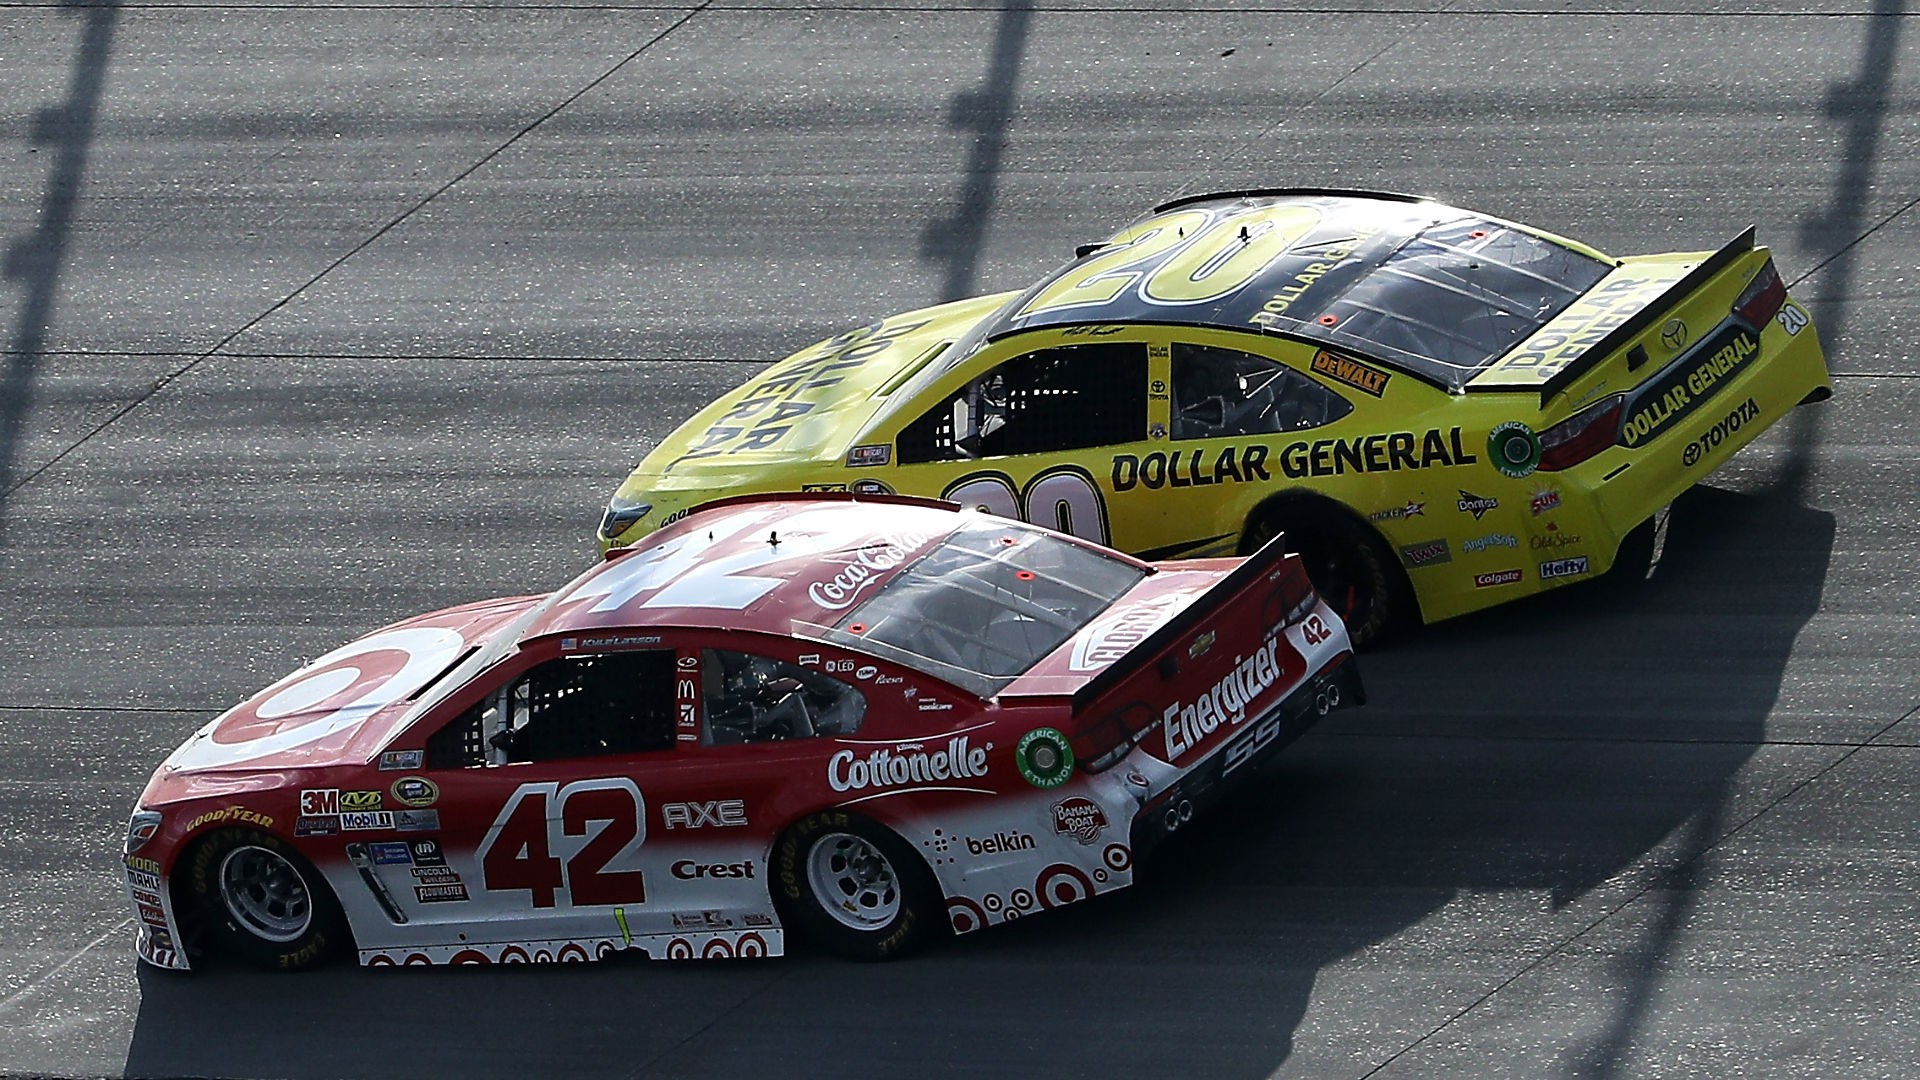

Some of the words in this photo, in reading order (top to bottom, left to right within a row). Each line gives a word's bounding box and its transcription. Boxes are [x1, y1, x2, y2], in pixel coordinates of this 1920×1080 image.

[1011, 203, 1325, 323] 20
[1248, 260, 1336, 327] DOLLAR
[1500, 279, 1650, 372] DOLLAR
[1775, 304, 1808, 336] 20
[1622, 386, 1690, 447] DOLLAR
[1687, 331, 1758, 396] GENERAL
[1490, 422, 1530, 442] AMERICAN
[1701, 398, 1760, 455] TOYOTA
[1111, 445, 1270, 492] DOLLAR
[1280, 427, 1478, 478] GENERAL
[1501, 462, 1538, 478] ETHANOL
[557, 502, 920, 614] 42
[1541, 558, 1586, 577] Hefty
[1478, 571, 1520, 584] Colgate
[1301, 614, 1333, 647] 42
[838, 662, 854, 672] LED
[1163, 636, 1281, 763] Energizer
[1018, 728, 1068, 757] AMERICAN
[828, 736, 988, 792] Cottonelle
[1024, 761, 1072, 787] ETHANOL
[302, 790, 338, 815] 3M
[662, 799, 748, 830] AXE
[1056, 804, 1100, 821] BANANA
[186, 804, 273, 832] GOODYEAR
[343, 813, 377, 827] Mobil
[1064, 817, 1095, 833] BOAT
[475, 777, 647, 908] 42
[966, 830, 1036, 857] belkin
[127, 855, 160, 875] MOOG
[412, 867, 450, 876] LINCOLN
[670, 860, 755, 880] Crest
[419, 886, 463, 900] FLOWMASTER
